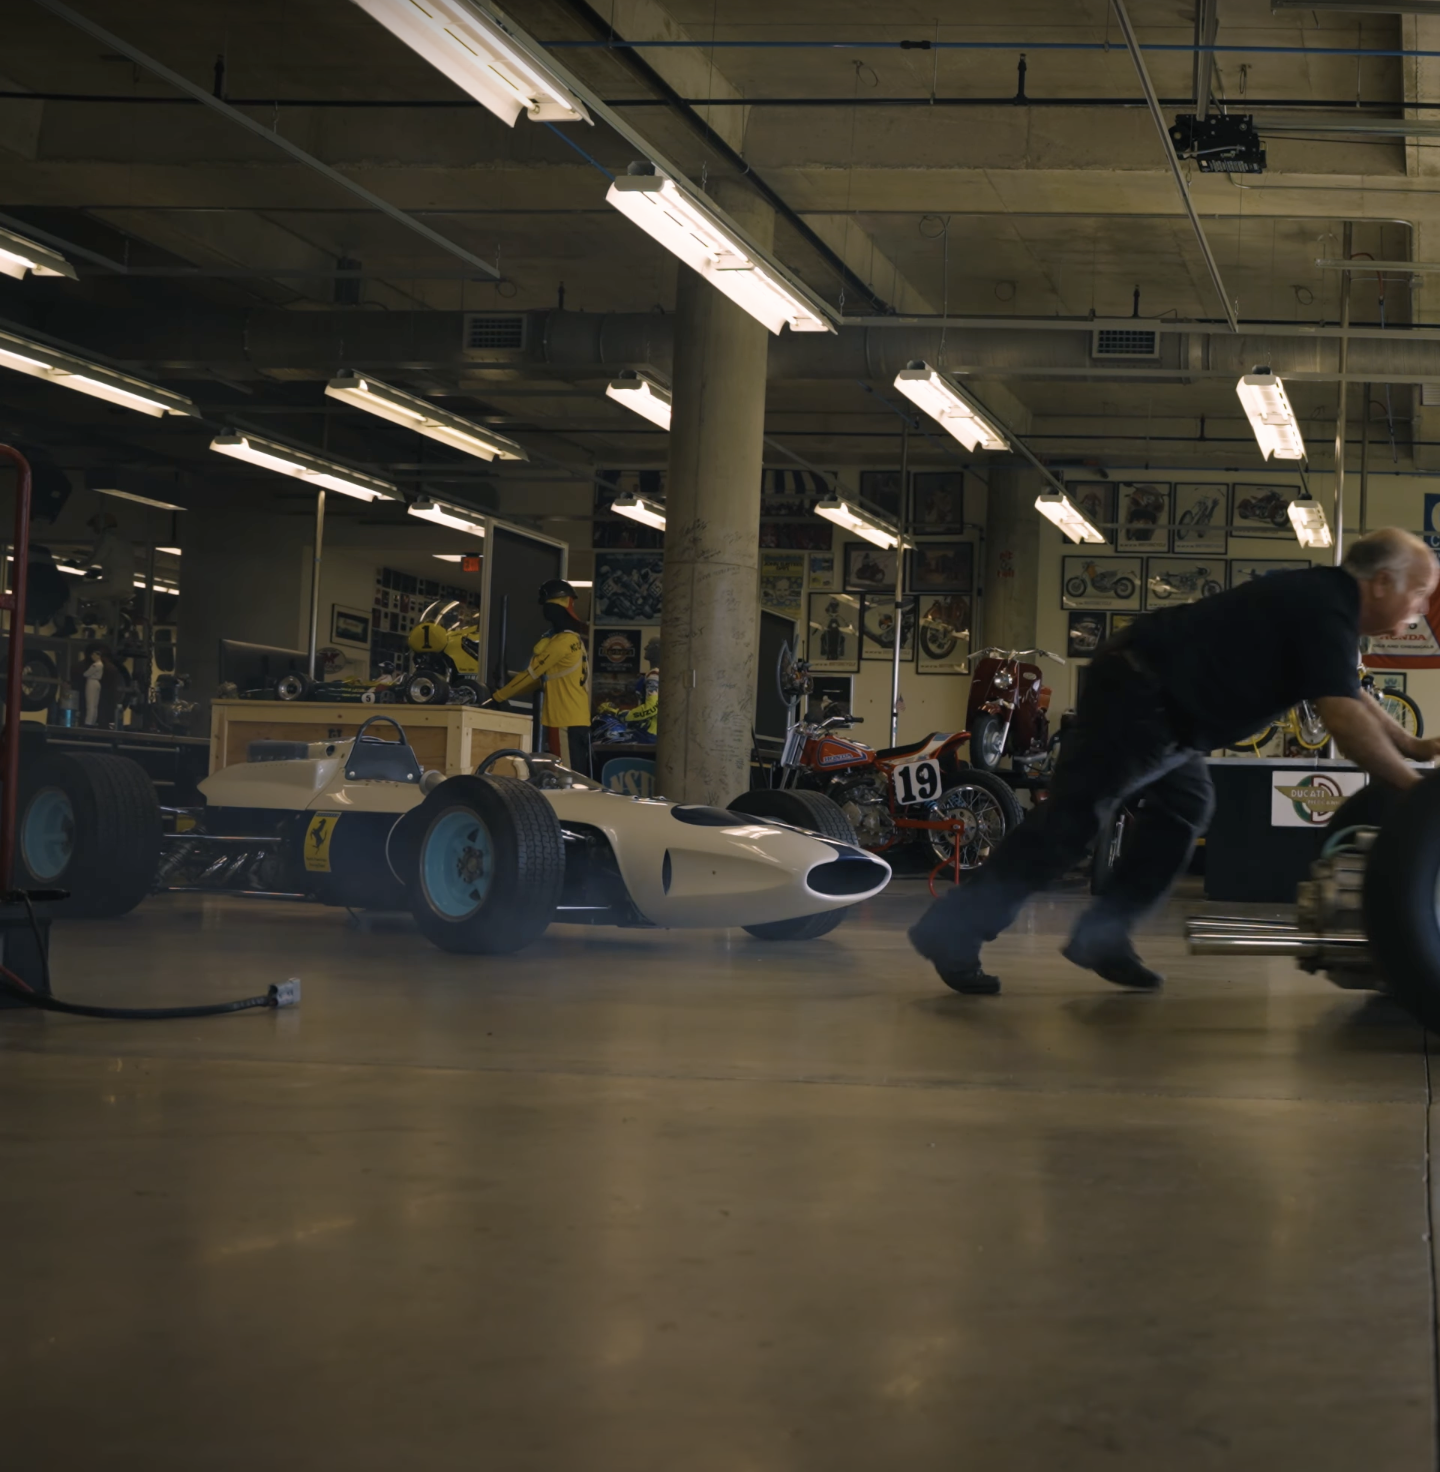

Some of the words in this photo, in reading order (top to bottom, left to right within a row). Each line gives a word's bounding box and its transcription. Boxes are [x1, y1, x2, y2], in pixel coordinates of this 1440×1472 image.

[421, 625, 432, 649] 1
[823, 753, 854, 763] HONDA
[898, 762, 938, 803] 19
[1291, 789, 1325, 798] DUCATI
